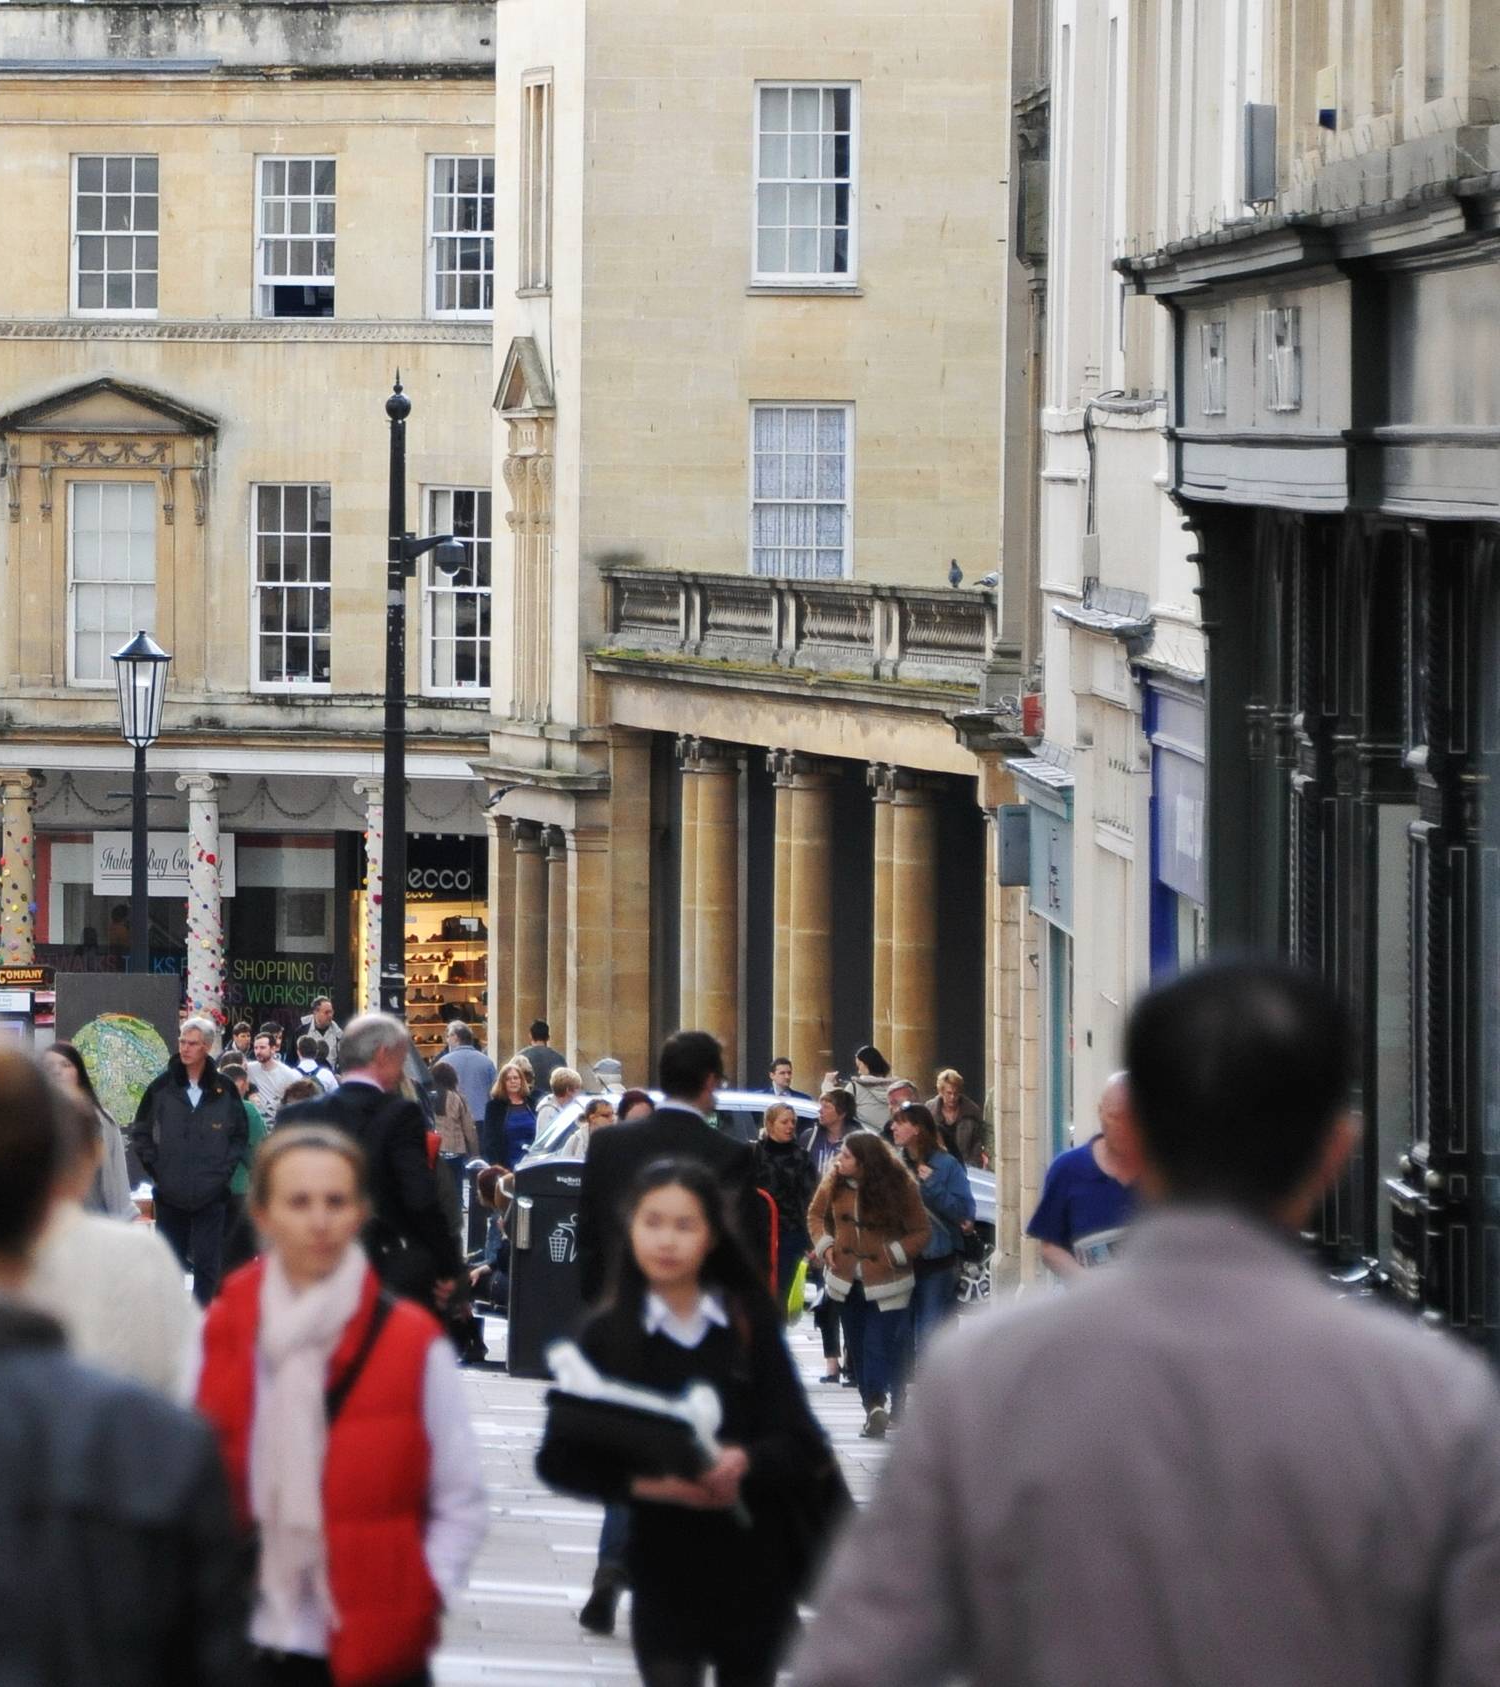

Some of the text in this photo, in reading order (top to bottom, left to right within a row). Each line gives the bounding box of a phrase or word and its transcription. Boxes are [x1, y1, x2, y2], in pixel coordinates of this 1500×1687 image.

[101, 847, 133, 871] Italia
[408, 868, 471, 890] ecco
[233, 959, 314, 983] SHOPPING
